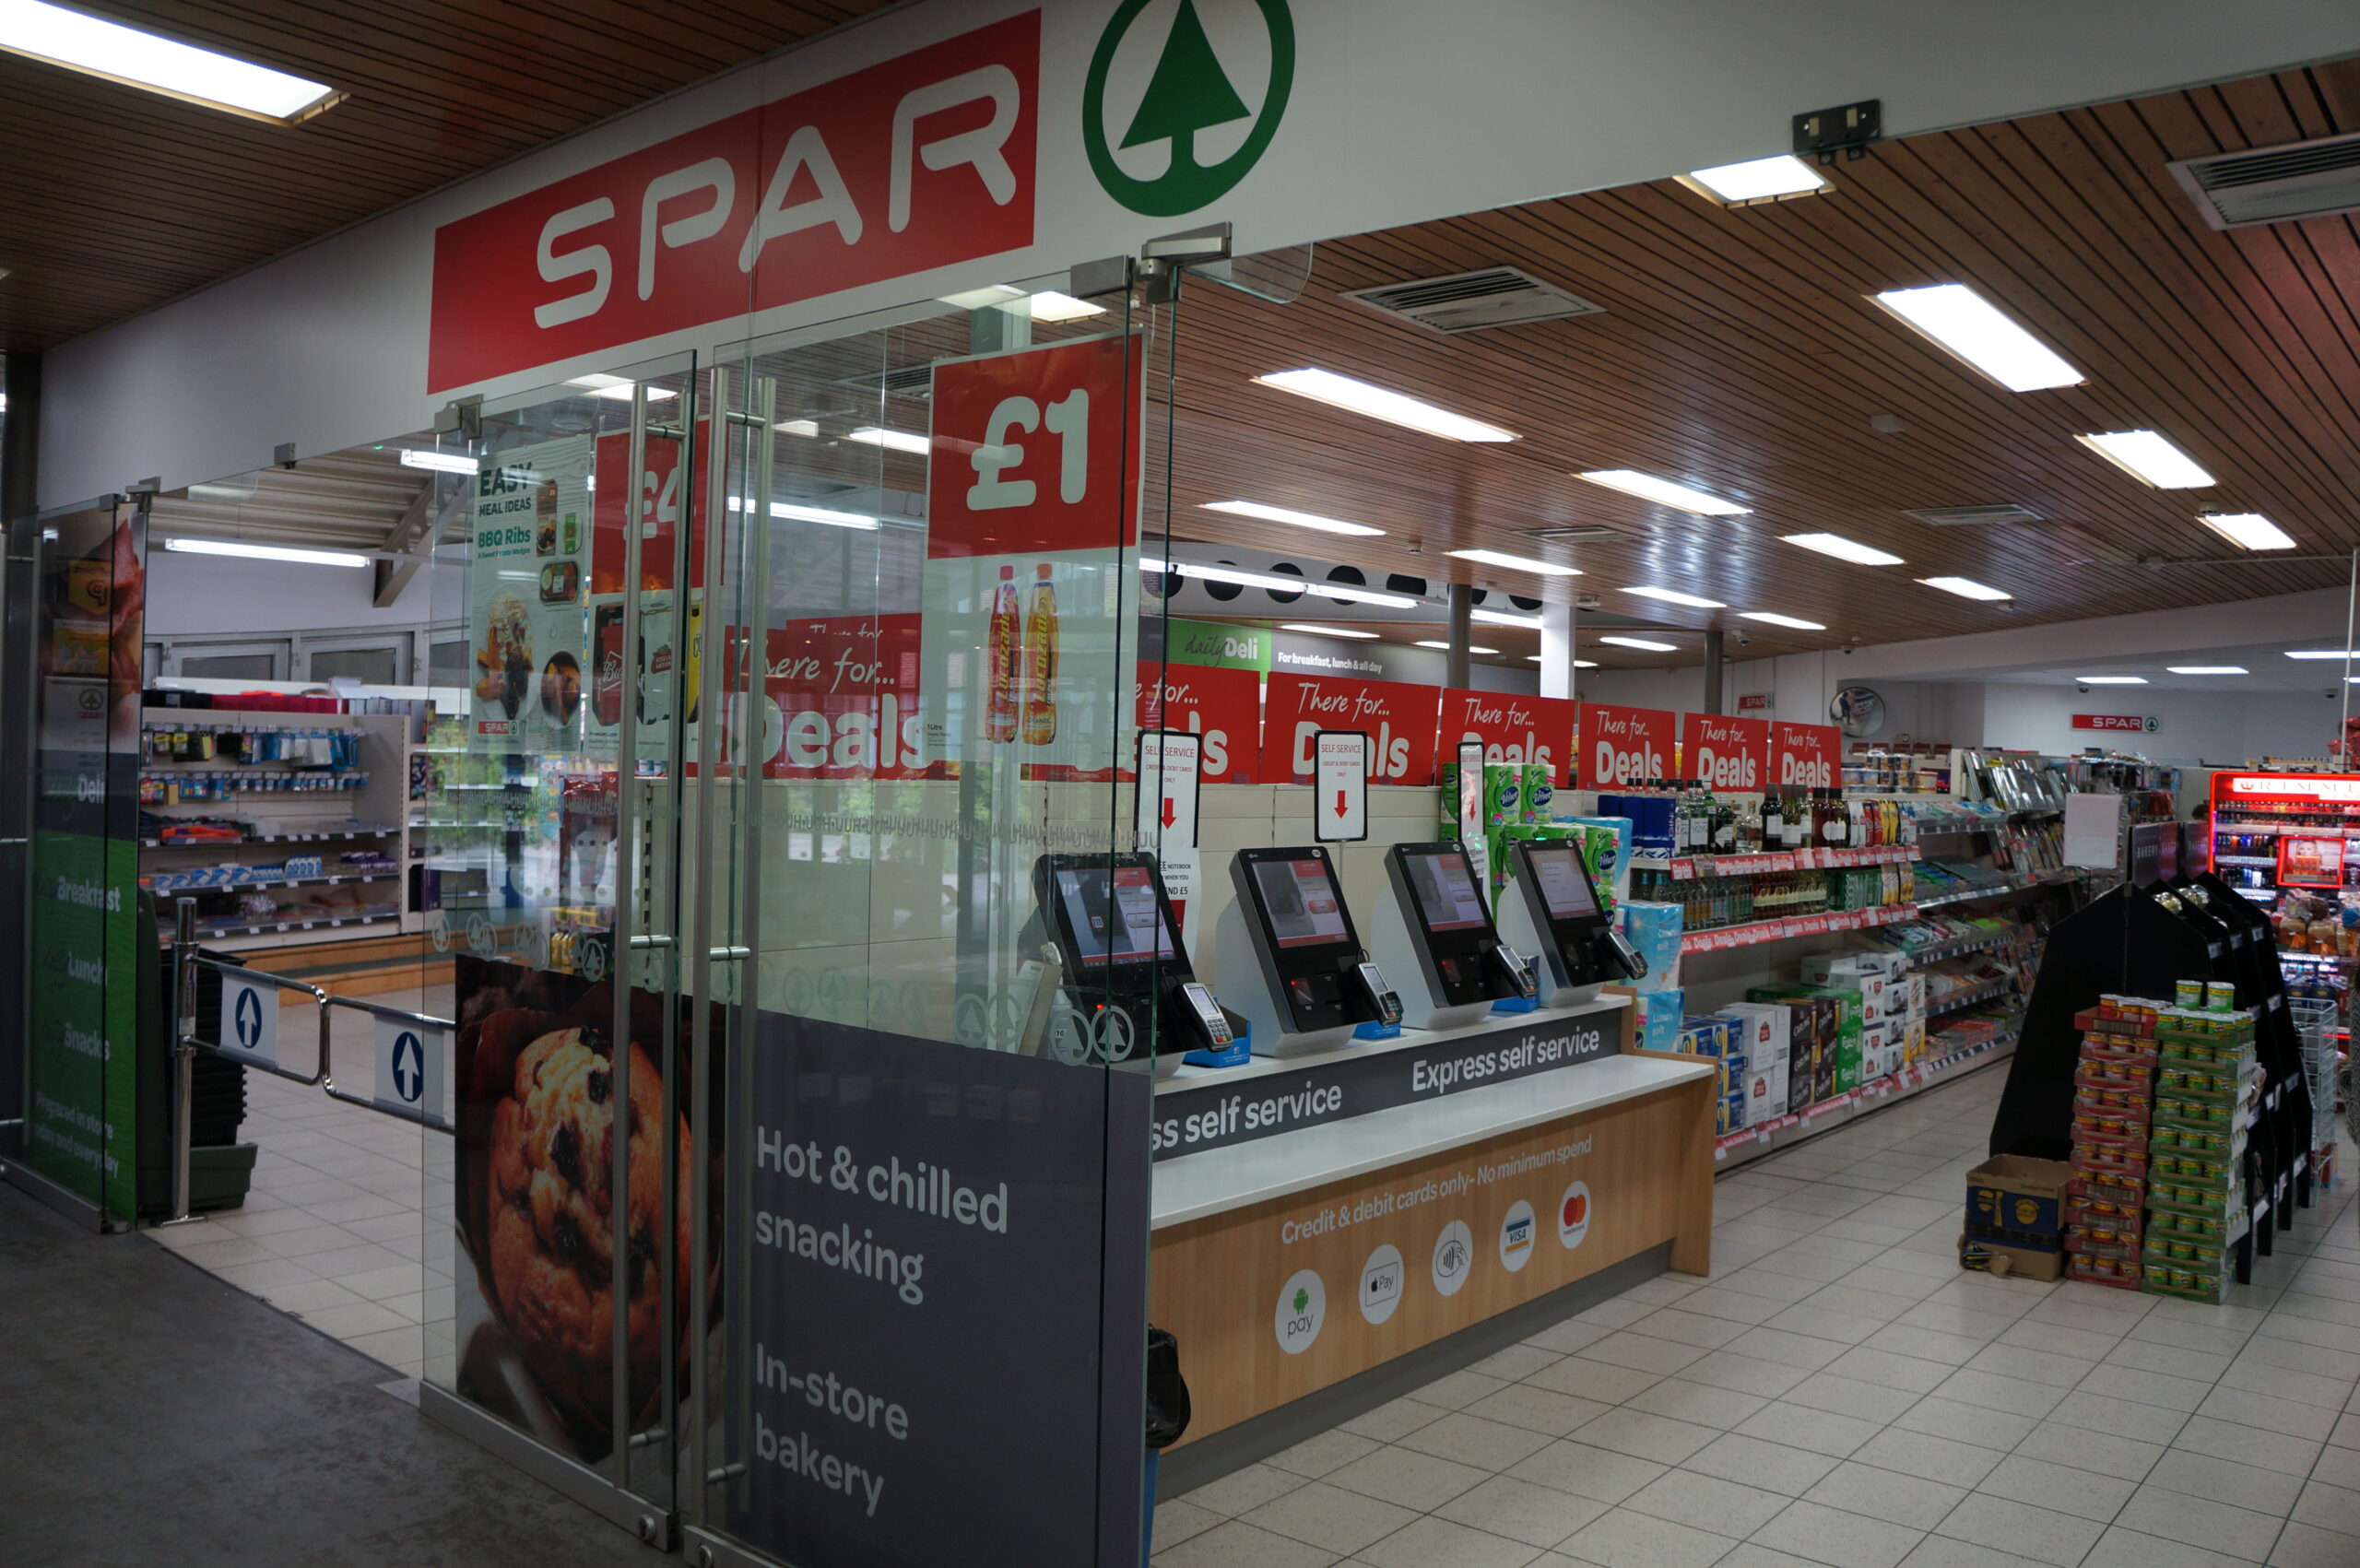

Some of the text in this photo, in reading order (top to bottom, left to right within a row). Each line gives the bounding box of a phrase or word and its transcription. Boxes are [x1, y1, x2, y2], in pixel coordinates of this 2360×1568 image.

[534, 64, 1021, 329] SPAR
[967, 389, 1089, 511] £1
[480, 461, 532, 497] EASY
[478, 497, 532, 517] MEAL IDEAS
[478, 525, 531, 548] BBQ Ribs
[1032, 607, 1049, 703] Lucozade
[1224, 637, 1258, 659] Deli
[1278, 651, 1383, 675] For breakfast, lunch & all day
[831, 647, 895, 693] for...
[1298, 682, 1390, 723] There for...
[1465, 698, 1535, 733] There for...
[1745, 697, 1765, 708] SPAR
[485, 723, 509, 732] SPAR
[726, 692, 937, 770] Deals
[1028, 716, 1050, 725] ORANGE
[1597, 711, 1650, 742] There for...
[1700, 719, 1747, 748] There for...
[2092, 716, 2142, 729] SPAR
[1164, 746, 1195, 759] SERVICE
[1292, 721, 1410, 778] Dls
[1321, 744, 1362, 753] SELF SERVICE
[1462, 731, 1552, 765] eals
[1783, 726, 1822, 752] There for...
[1596, 740, 1662, 785] Deals
[1697, 747, 1756, 787] Deals
[1781, 751, 1831, 788] Deals
[77, 772, 104, 804] Deli
[57, 876, 121, 913] Breakfast
[1180, 886, 1188, 895] £5
[67, 951, 108, 986] Lunch
[64, 1021, 111, 1061] Snacks
[1412, 1026, 1599, 1094] Express self service
[1185, 1095, 1241, 1143] self
[1245, 1080, 1341, 1130] service
[33, 1122, 55, 1149] oday
[757, 1126, 1008, 1233] Hot & chilled
[1281, 1209, 1336, 1244] Credit
[1338, 1206, 1351, 1228] &
[1353, 1193, 1395, 1223] debit
[1397, 1180, 1437, 1210] cards
[1477, 1165, 1495, 1186] No
[1497, 1149, 1556, 1180] minimum
[1556, 1134, 1592, 1165] spend
[1509, 1228, 1527, 1244] VISA
[756, 1210, 924, 1305] snacking
[1379, 1273, 1394, 1291] Pay
[1287, 1314, 1314, 1340] pay
[756, 1342, 909, 1440] In-store
[756, 1412, 884, 1517] bakery
